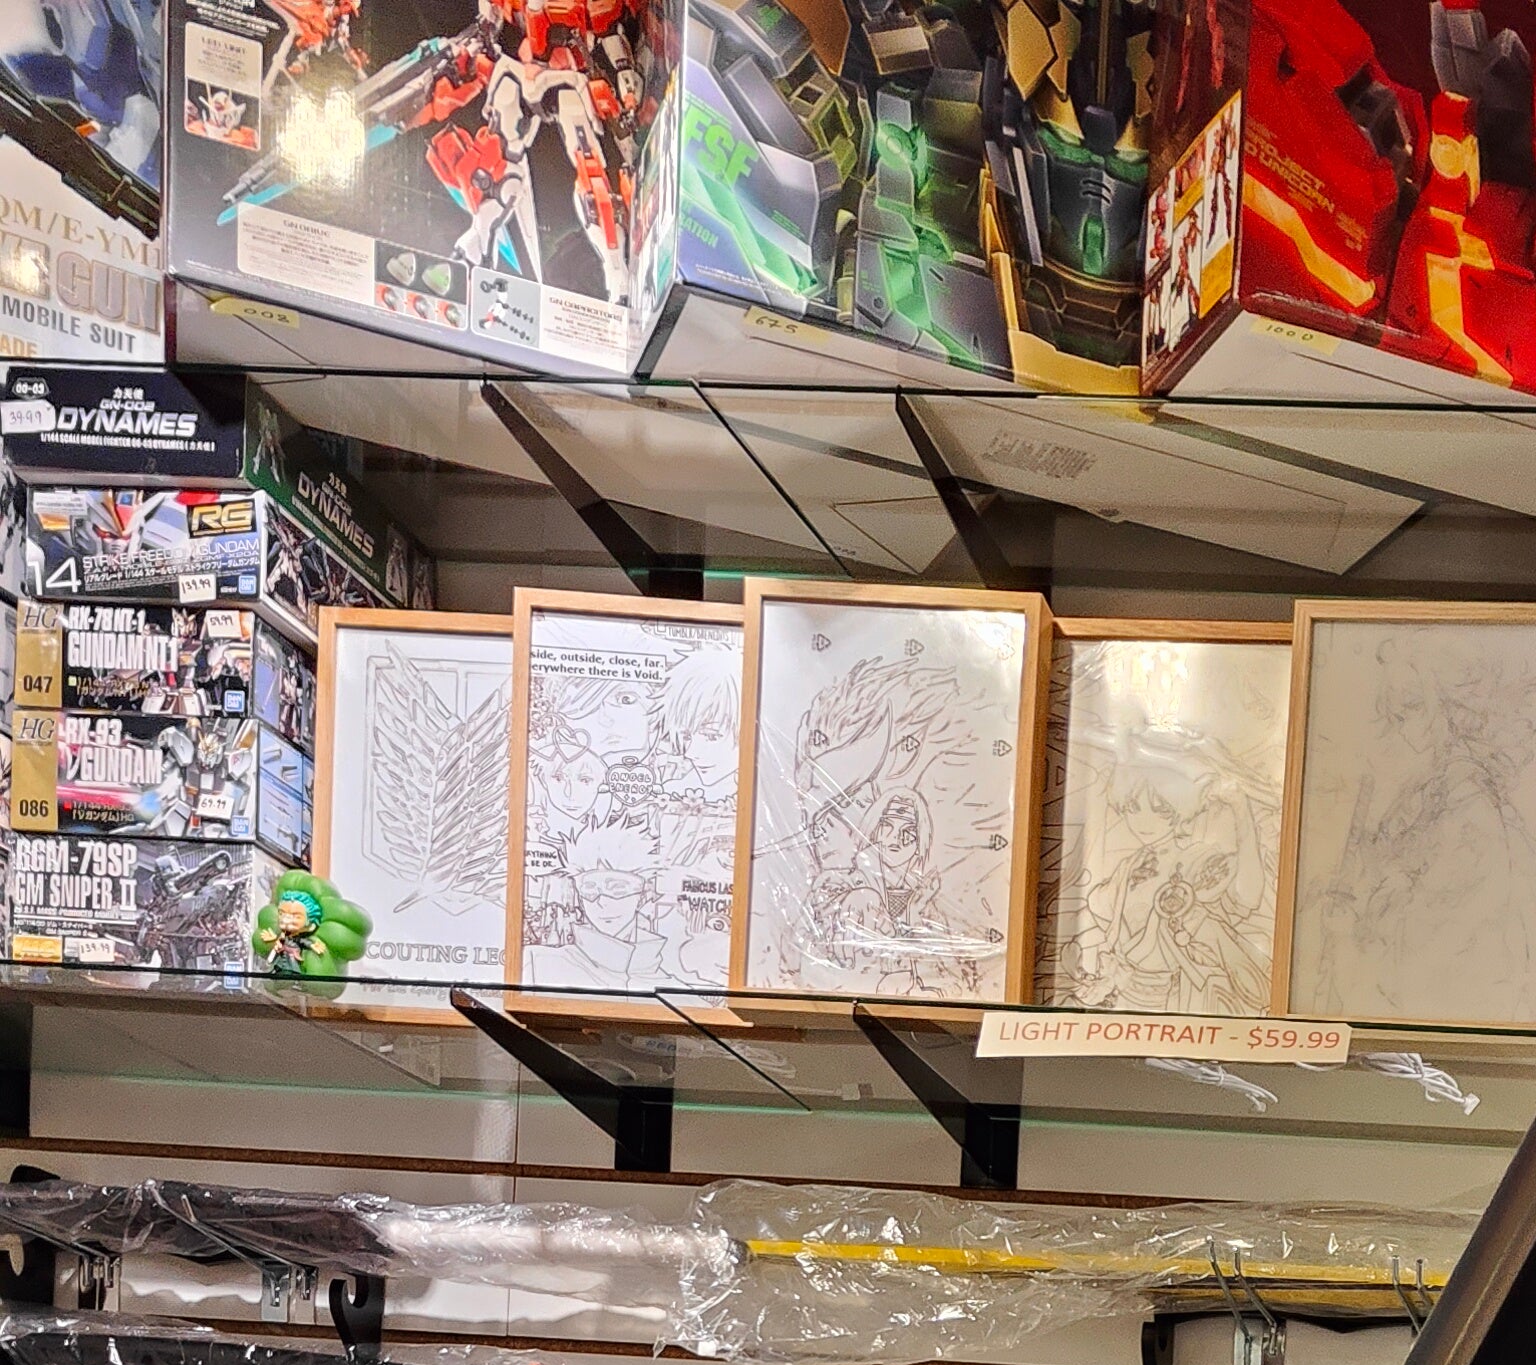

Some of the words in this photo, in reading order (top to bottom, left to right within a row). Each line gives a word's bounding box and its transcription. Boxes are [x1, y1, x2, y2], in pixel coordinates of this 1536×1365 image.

[2, 295, 81, 338] MOBILE
[90, 322, 136, 353] SUIT
[57, 406, 199, 437] DYNAMES
[191, 501, 254, 533] RG
[298, 471, 375, 558] DYNAMES
[82, 554, 127, 569] STRIKE
[199, 538, 260, 556] GUNDAM
[27, 557, 82, 596] 14
[24, 606, 60, 629] HG
[67, 630, 142, 669] GUNDAM
[560, 652, 606, 665] outside,
[608, 657, 641, 668] close,
[644, 658, 664, 669] far.
[23, 674, 53, 693] 047
[588, 666, 619, 678] there
[621, 667, 631, 678] is
[634, 669, 663, 681] Void.
[20, 718, 54, 740] HG
[65, 717, 123, 746] RX-93
[81, 747, 163, 784] GUNDAM
[610, 770, 651, 782] ANGEL
[19, 800, 48, 817] 086
[15, 871, 43, 904] GM
[49, 875, 113, 911] SNIPER
[366, 941, 469, 964] COUTING
[1000, 1021, 1078, 1041] LIGHT
[1087, 1023, 1222, 1046] PORTRAIT
[1247, 1027, 1340, 1050] $59.99
